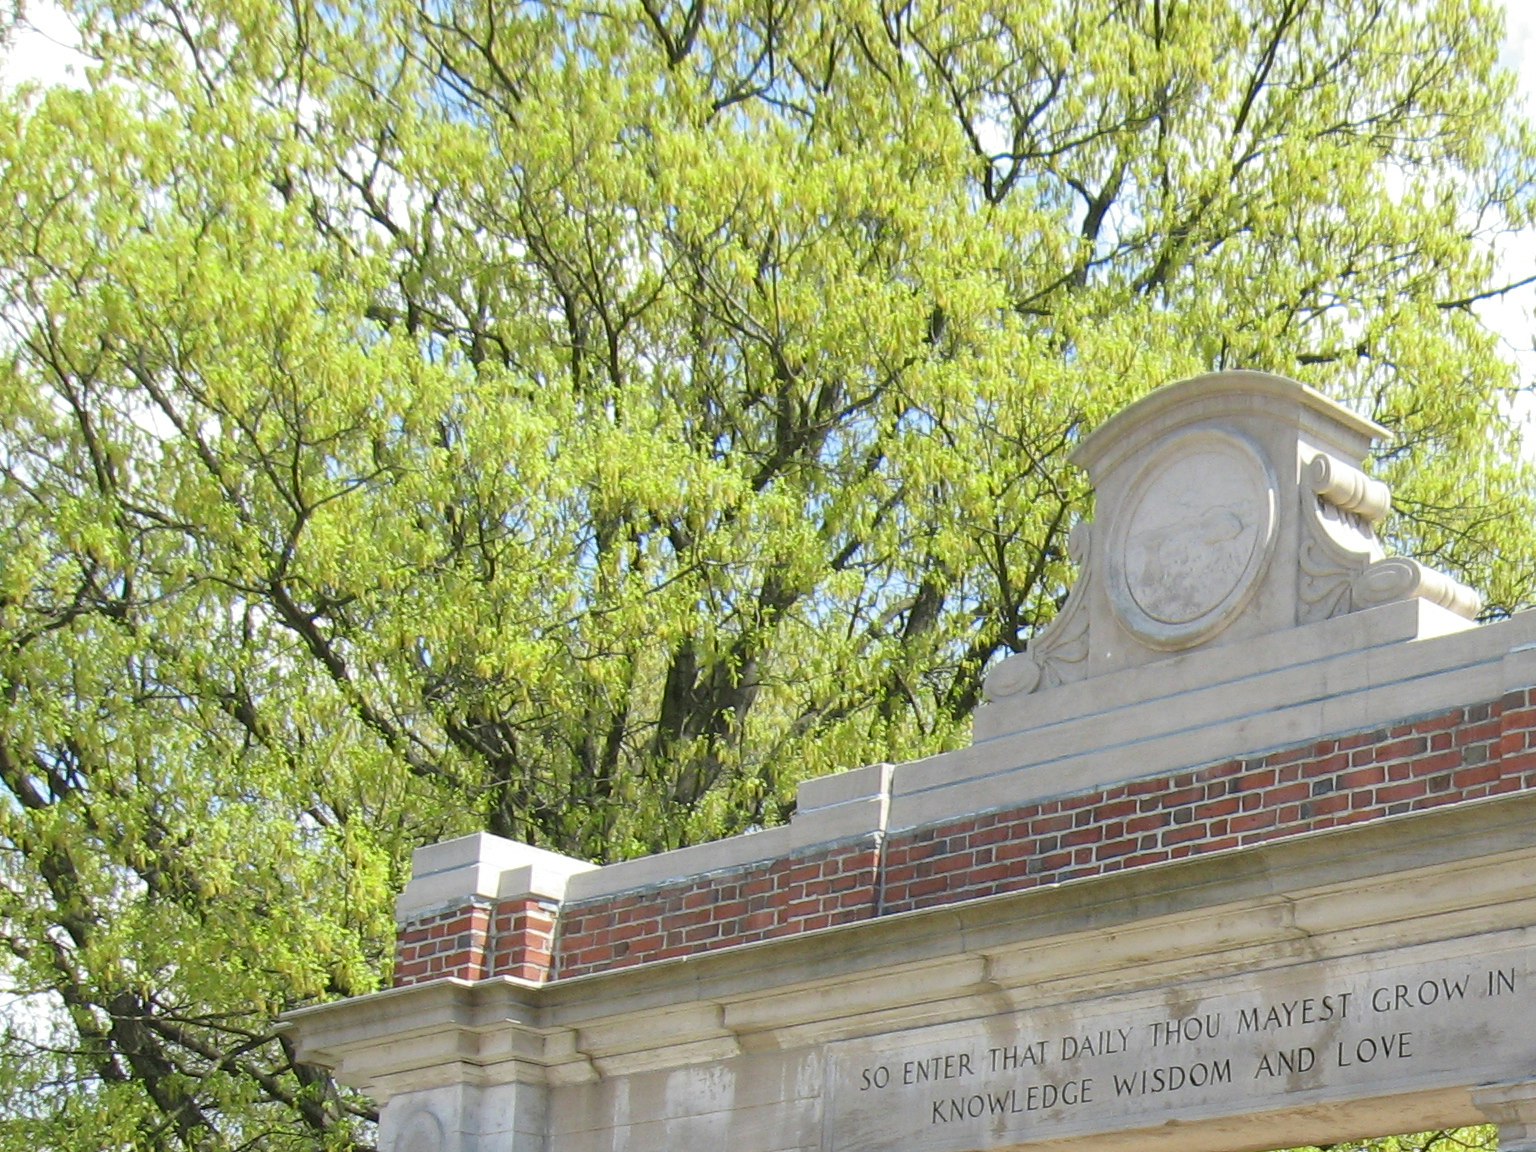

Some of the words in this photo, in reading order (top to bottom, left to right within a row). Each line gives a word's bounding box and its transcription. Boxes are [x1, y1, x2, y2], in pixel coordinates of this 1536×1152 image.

[861, 1067, 890, 1091] SO
[903, 1053, 975, 1085] ENTER
[989, 1040, 1049, 1072] THAT
[1060, 1026, 1134, 1061] DAILY
[1149, 1013, 1222, 1046] THOU
[1237, 992, 1353, 1034] MAYEST
[1371, 974, 1471, 1013] GROW
[1487, 967, 1516, 997] IN
[931, 1079, 1094, 1124] KNOWLEDGE
[1113, 1058, 1232, 1097] WISDOM
[1254, 1047, 1316, 1079] AND
[1337, 1032, 1413, 1067] LOVE
